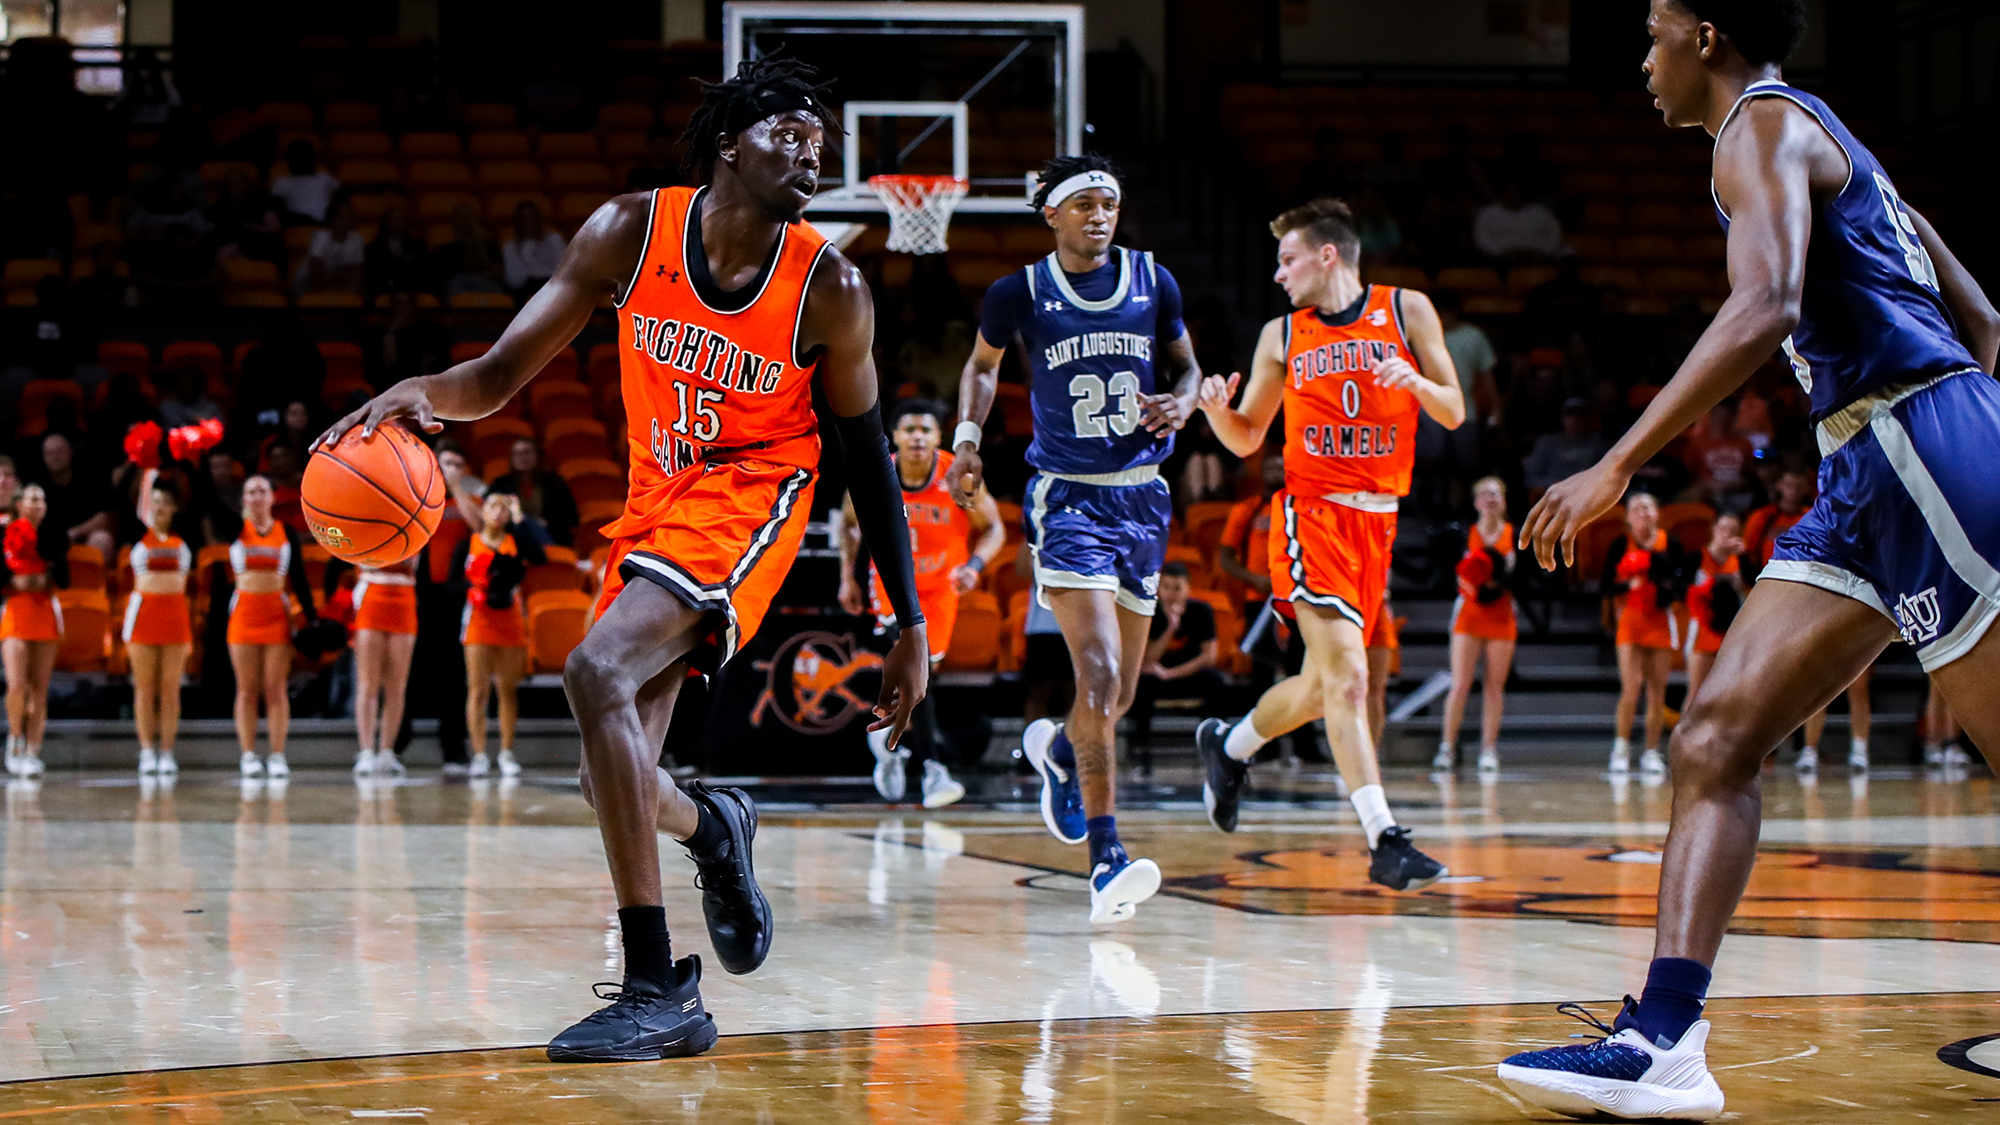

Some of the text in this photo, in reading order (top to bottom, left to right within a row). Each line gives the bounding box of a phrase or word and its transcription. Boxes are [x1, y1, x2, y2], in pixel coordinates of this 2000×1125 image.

[632, 313, 785, 394] FIGHTING
[1044, 335, 1080, 370] SAINT
[672, 379, 725, 442] 15
[1069, 370, 1141, 439] 23
[1341, 379, 1361, 419] 0
[1304, 424, 1397, 458] CAMELS
[1894, 586, 1941, 646] AU
